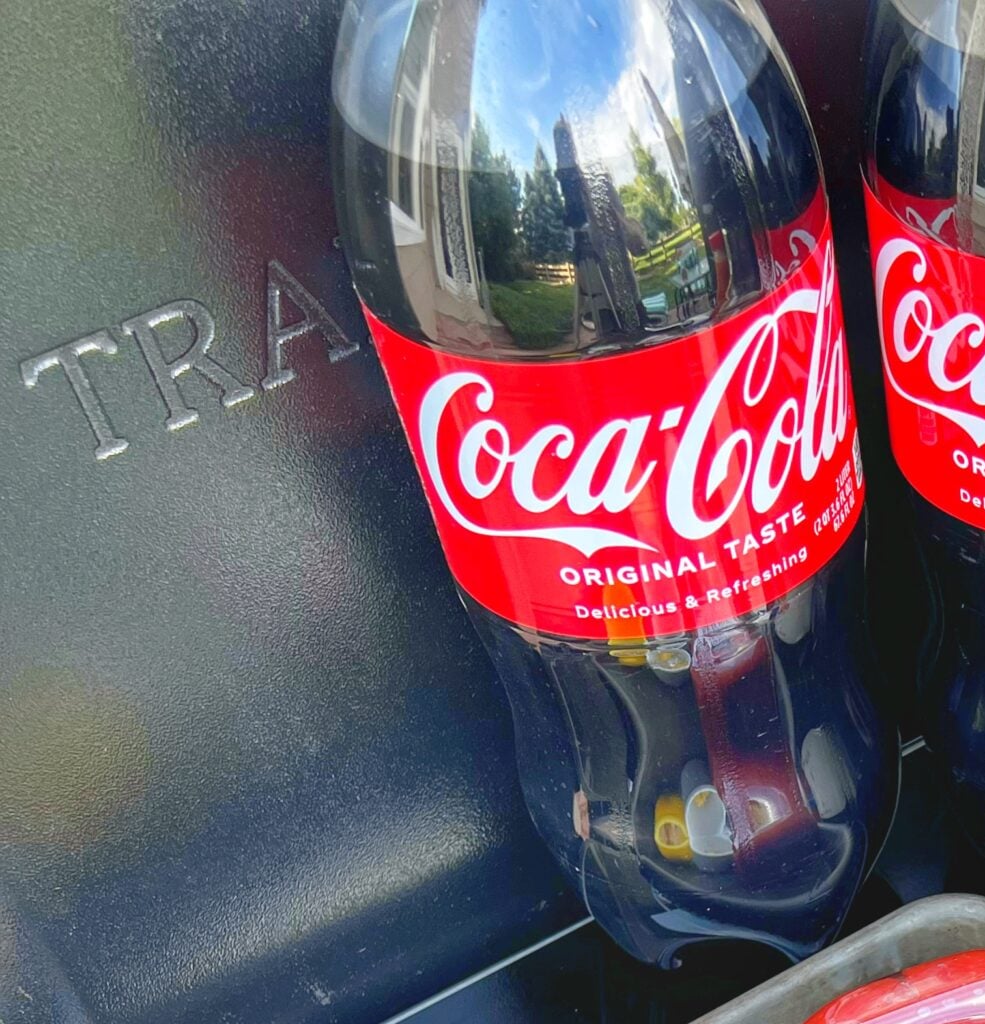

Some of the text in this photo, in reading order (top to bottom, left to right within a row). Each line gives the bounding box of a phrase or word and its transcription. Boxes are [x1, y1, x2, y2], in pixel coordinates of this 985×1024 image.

[419, 239, 847, 557] Coca-Cola
[559, 502, 806, 586] ORIGINAL TASTE
[575, 546, 809, 620] Delicious & Refreshing
